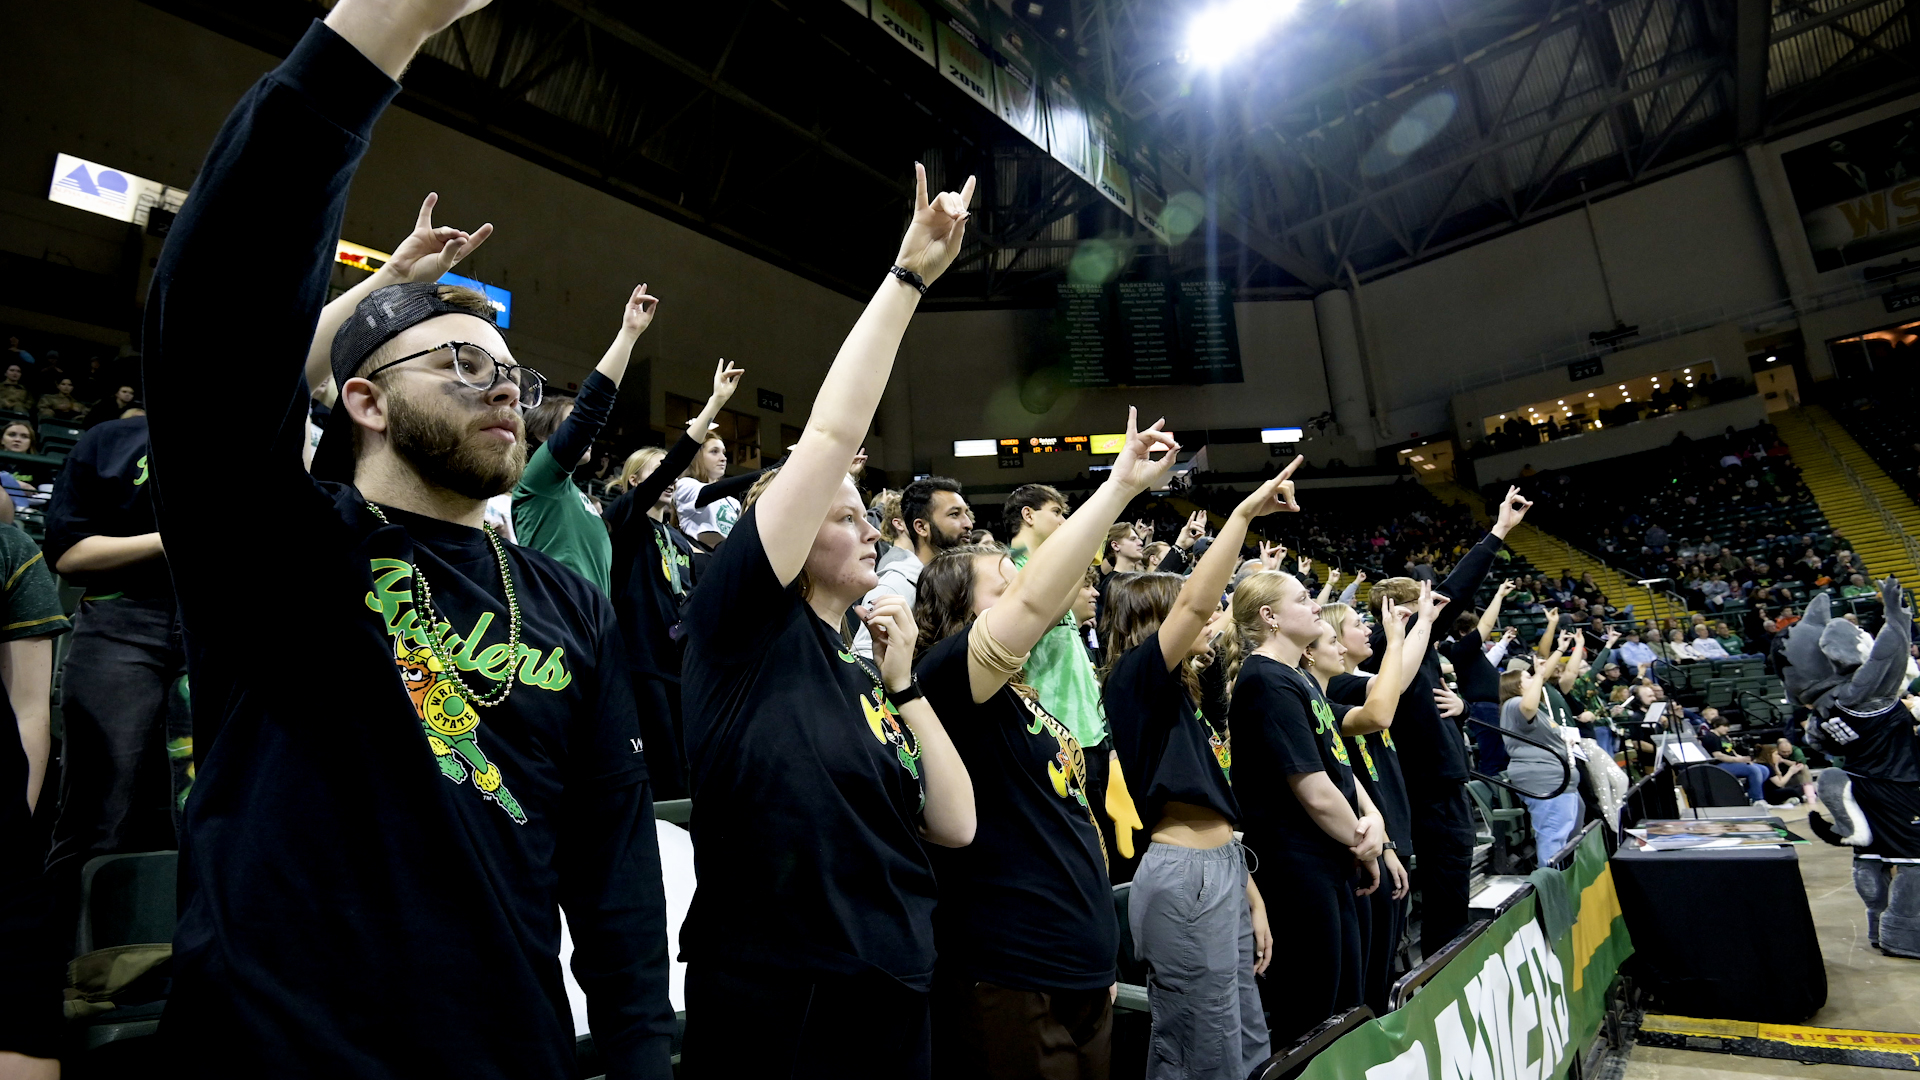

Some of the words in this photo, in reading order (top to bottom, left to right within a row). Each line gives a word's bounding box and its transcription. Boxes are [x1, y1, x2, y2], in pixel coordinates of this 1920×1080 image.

[882, 14, 924, 52] 2015
[949, 64, 985, 98] 2016
[1892, 296, 1920, 308] 218
[1575, 366, 1598, 378] 217
[762, 398, 780, 409] 214
[433, 711, 474, 729] STATE
